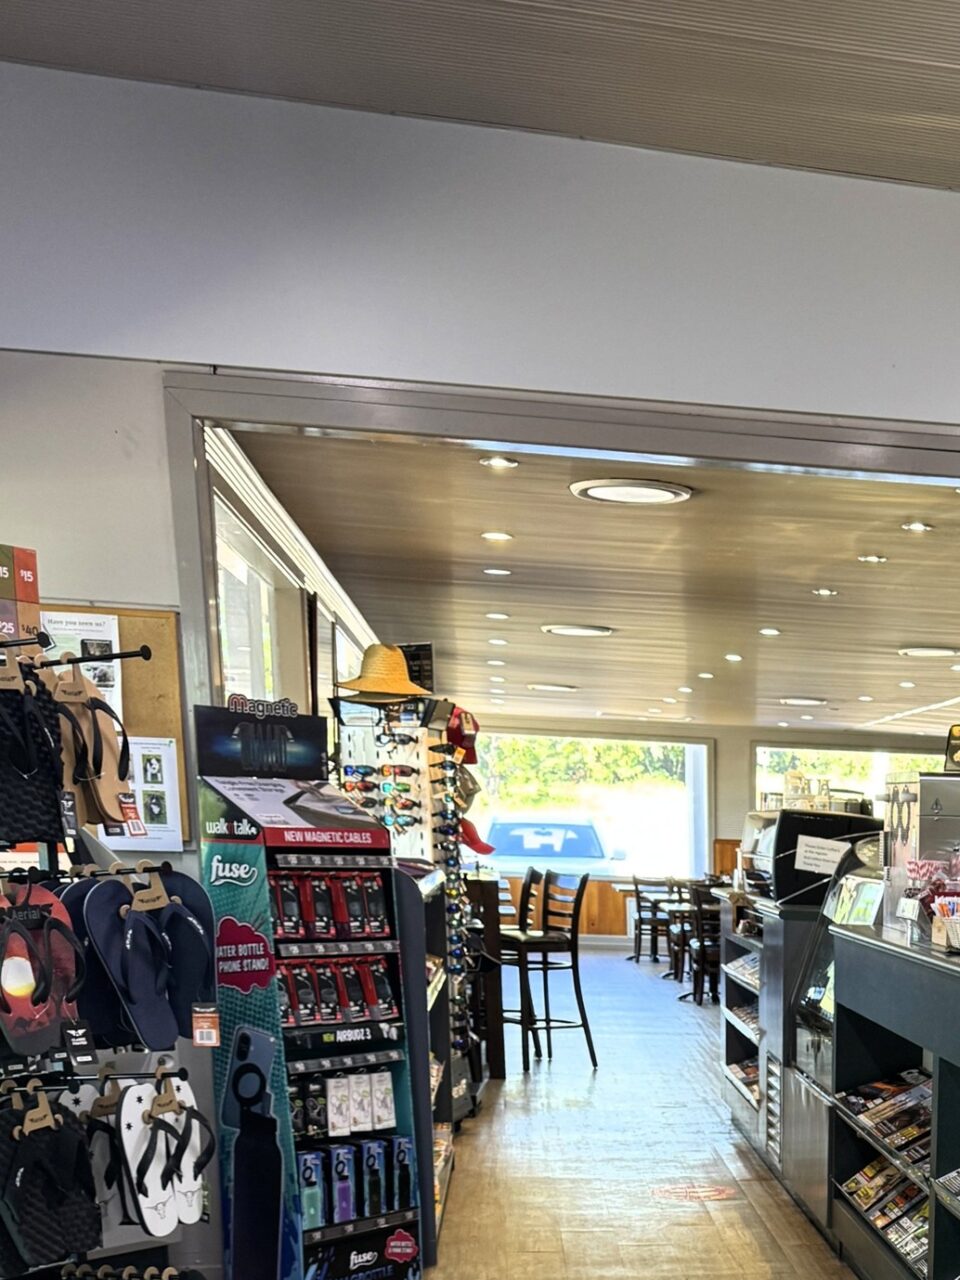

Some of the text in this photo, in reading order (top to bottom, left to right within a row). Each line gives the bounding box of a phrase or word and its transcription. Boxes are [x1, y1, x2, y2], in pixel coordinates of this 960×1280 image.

[284, 831, 372, 844] NEW MAGNETIC CABLES
[210, 855, 258, 886] fuse
[12, 906, 41, 921] Aerial
[238, 943, 264, 955] BOTTLE
[219, 957, 269, 973] PHONE STAND!
[350, 1251, 378, 1270] fuse
